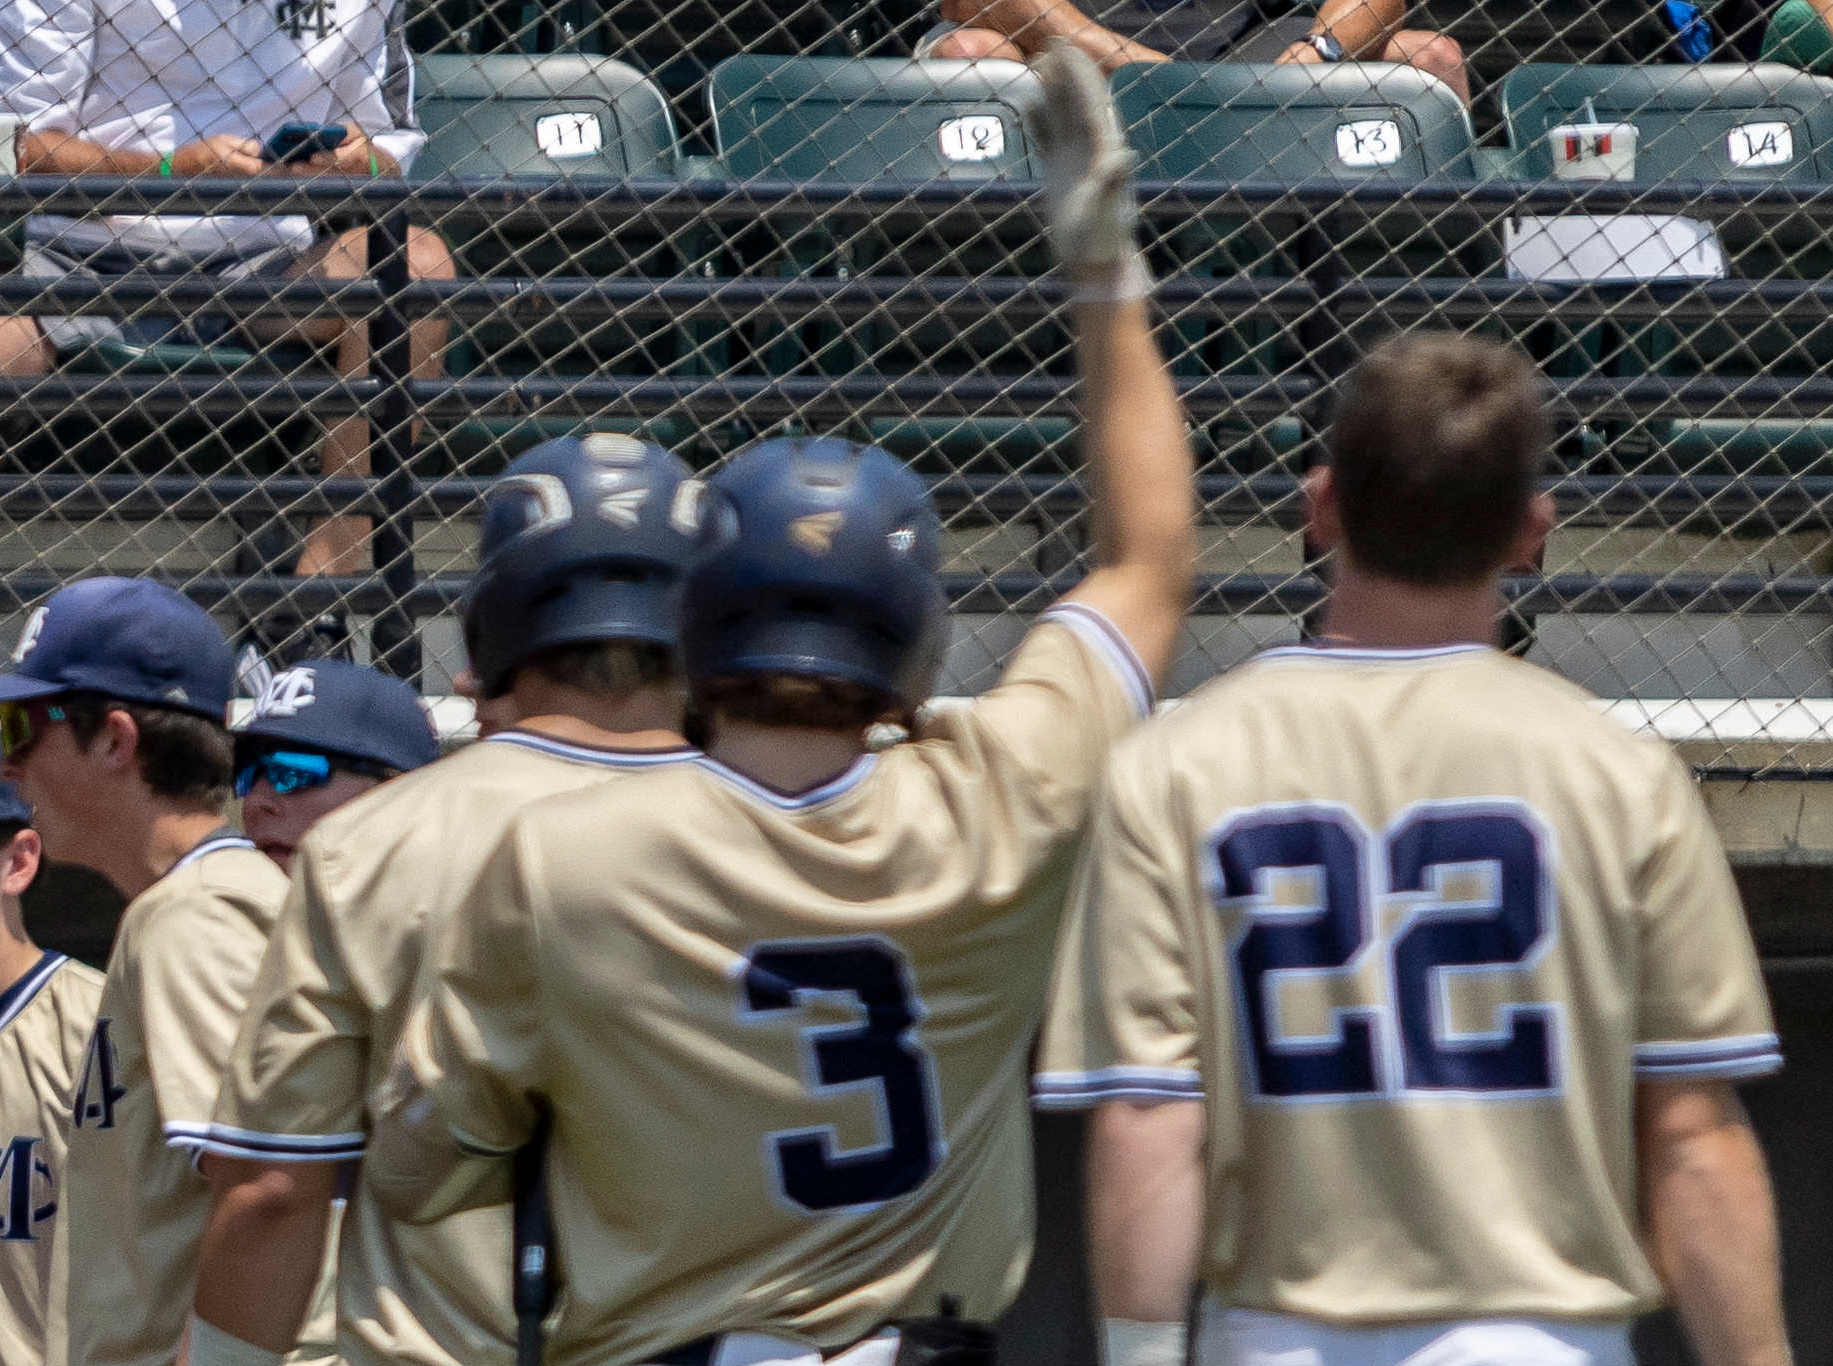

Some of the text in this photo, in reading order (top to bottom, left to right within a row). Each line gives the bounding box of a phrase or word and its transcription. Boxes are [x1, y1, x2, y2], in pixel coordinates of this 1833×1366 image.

[957, 126, 990, 151] 12
[734, 932, 939, 1216] 3
[1199, 795, 1563, 1101] 22
